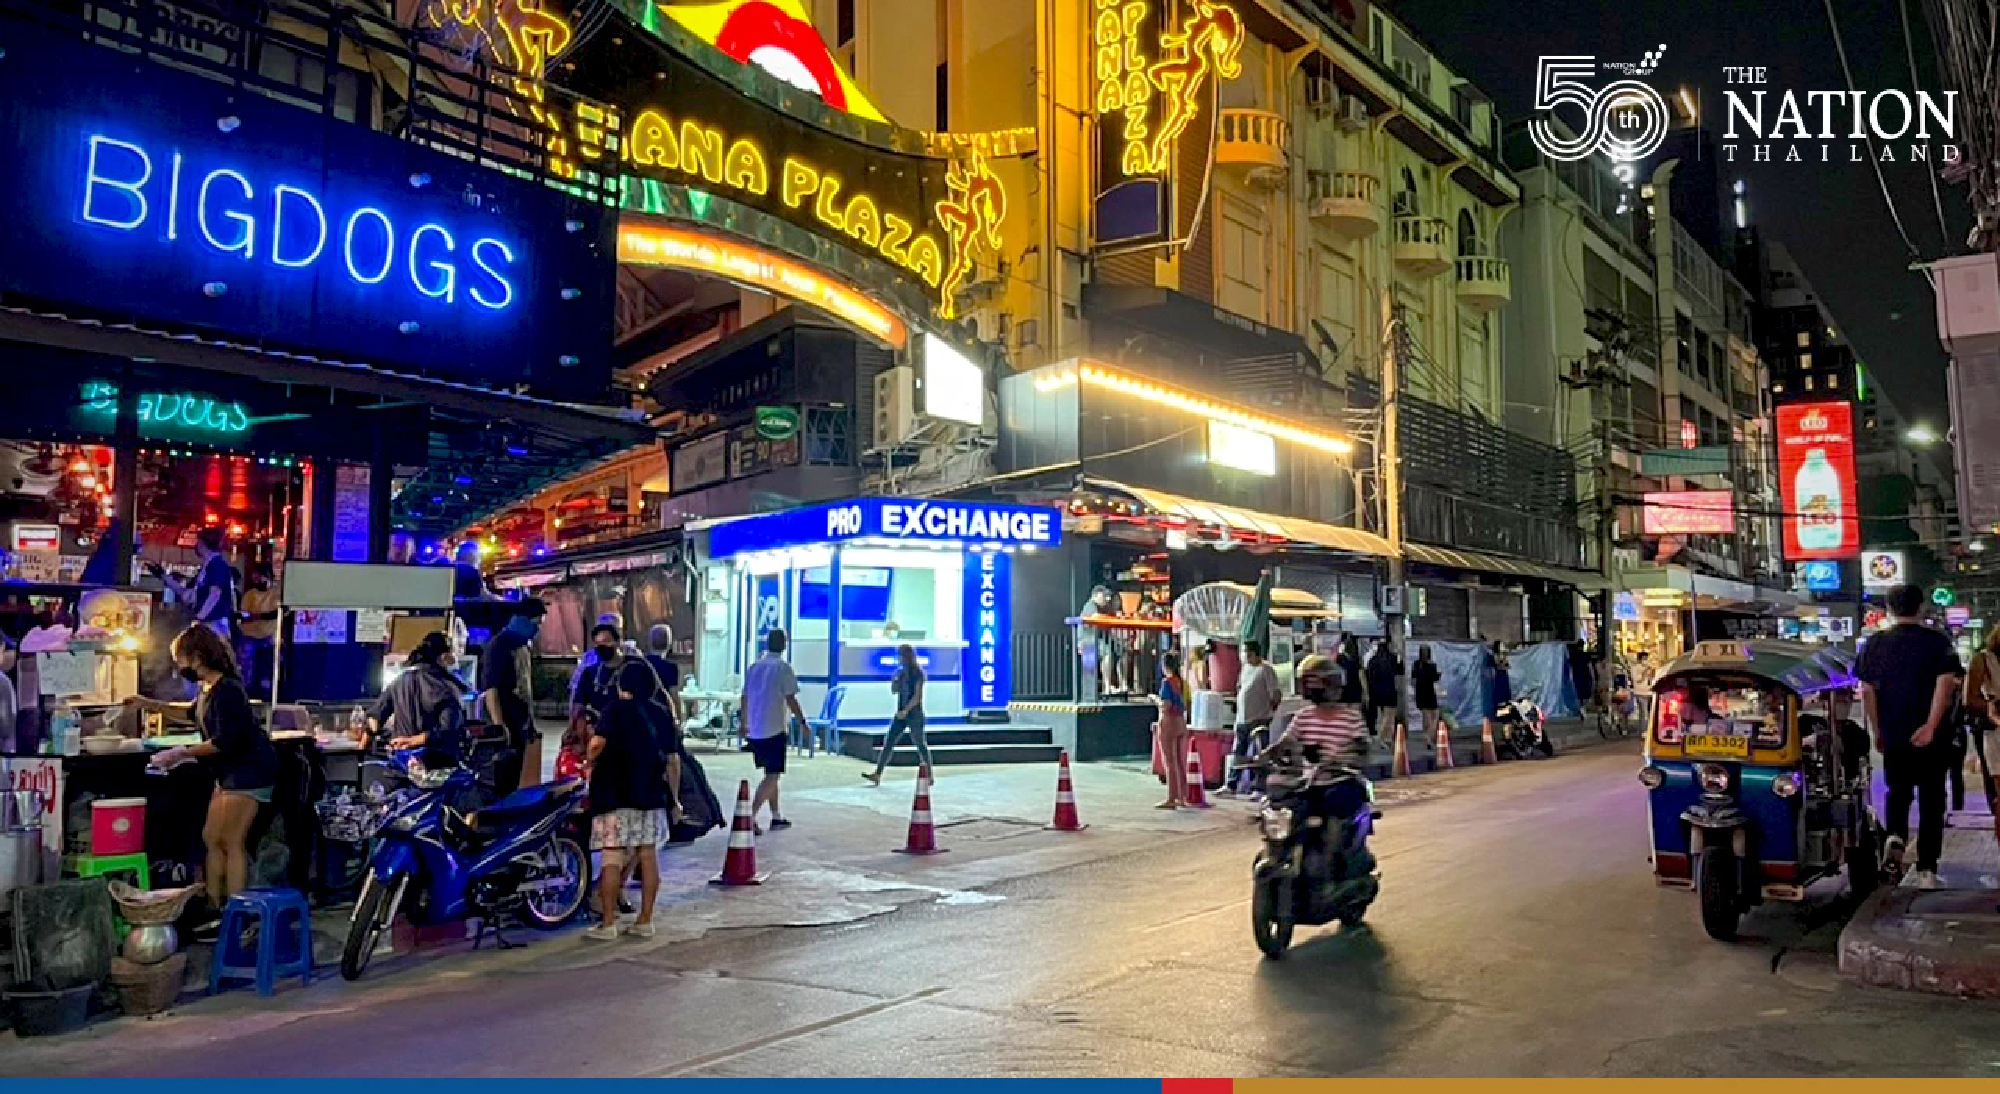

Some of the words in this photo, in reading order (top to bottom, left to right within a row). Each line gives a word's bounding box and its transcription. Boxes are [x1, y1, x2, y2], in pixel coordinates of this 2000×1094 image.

[1097, 0, 1122, 113] ANA
[1123, 2, 1149, 175] PLAZA
[81, 134, 515, 309] BIGDOGS
[783, 157, 942, 289] PLAZA
[827, 505, 862, 537] PRO
[880, 501, 1051, 541] EXCHANGE
[979, 554, 996, 703] EXCHANGE
[1711, 735, 1745, 748] 3302
